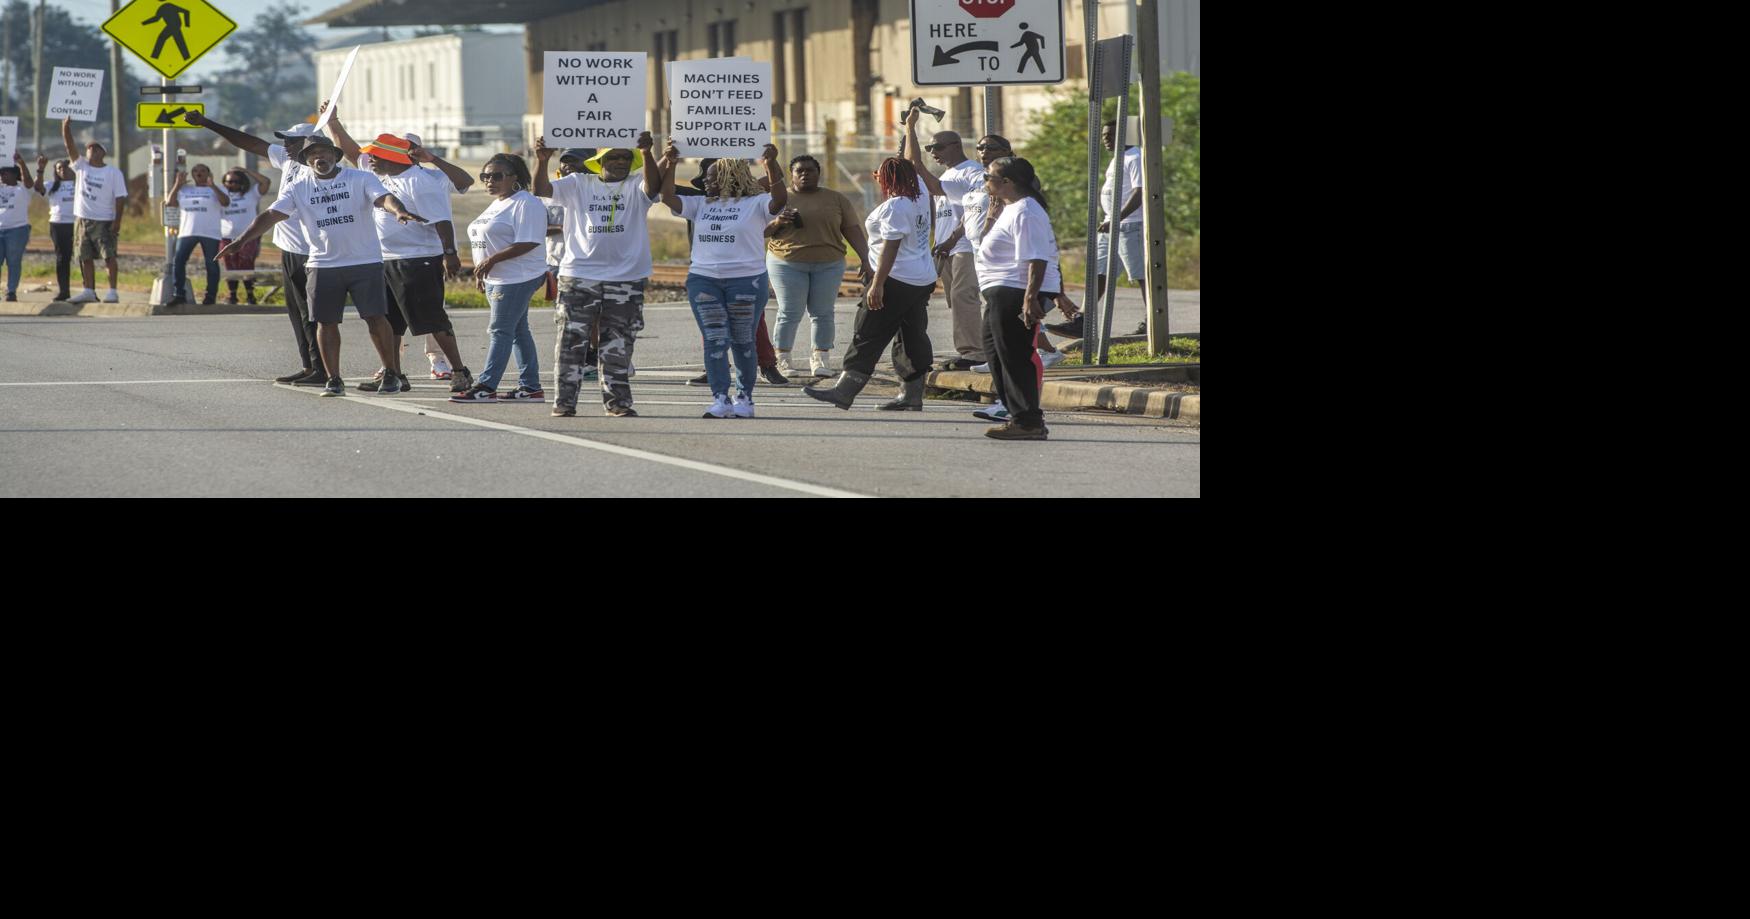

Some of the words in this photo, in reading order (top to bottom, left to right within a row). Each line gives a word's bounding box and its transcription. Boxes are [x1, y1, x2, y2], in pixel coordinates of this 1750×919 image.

[930, 23, 977, 38] HERE
[558, 58, 581, 68] NO
[586, 58, 633, 68] WORK
[978, 56, 999, 71] TO
[556, 75, 631, 85] WITHOUT
[684, 74, 760, 83] MACHINES
[587, 93, 598, 103] A
[680, 90, 724, 99] DON'T
[728, 90, 763, 99] FEED
[50, 107, 93, 115] CONTRACT
[687, 106, 756, 115] FAMILIES:
[577, 111, 612, 120] FAIR
[675, 121, 740, 131] SUPPORT
[745, 122, 767, 131] ILA
[551, 128, 637, 138] CONTRACT
[686, 137, 756, 147] WORKERS
[310, 191, 350, 205] STANDING
[327, 205, 338, 214] ON
[589, 203, 625, 211] STANDNG
[316, 215, 354, 228] BUSINESS
[701, 213, 739, 221] STANDING
[588, 225, 625, 233] BUSINESS
[710, 223, 722, 231] ON
[698, 234, 736, 243] BUSINESS
